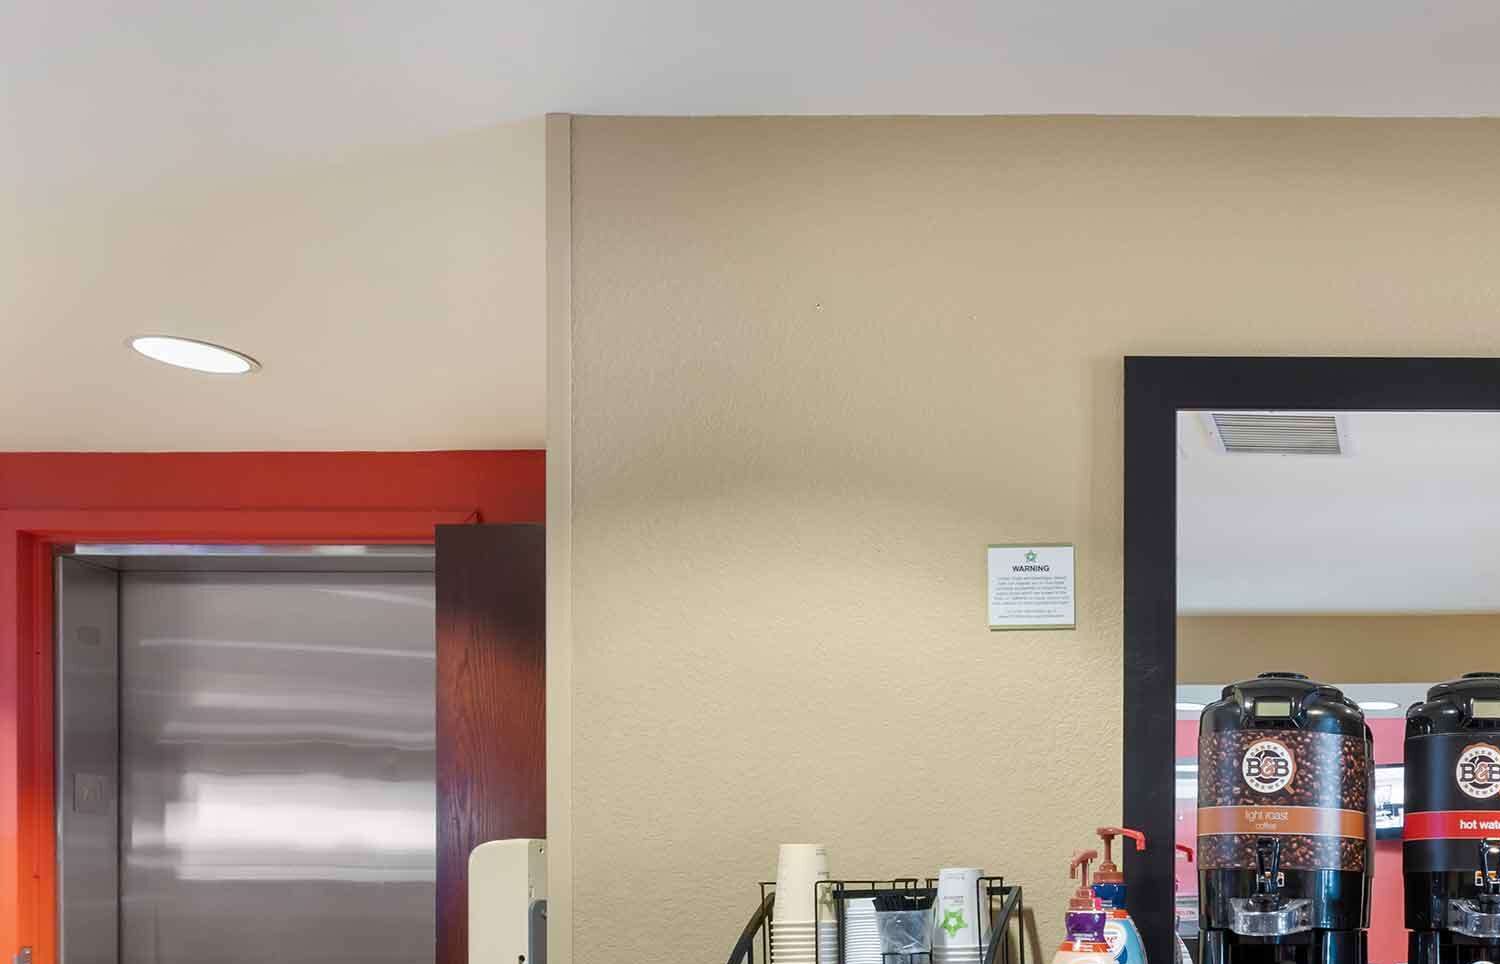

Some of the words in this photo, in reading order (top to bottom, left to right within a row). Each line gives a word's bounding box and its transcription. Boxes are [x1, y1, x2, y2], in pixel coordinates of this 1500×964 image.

[1246, 757, 1290, 778] B&B
[1265, 810, 1288, 820] roast
[1460, 819, 1477, 829] hot
